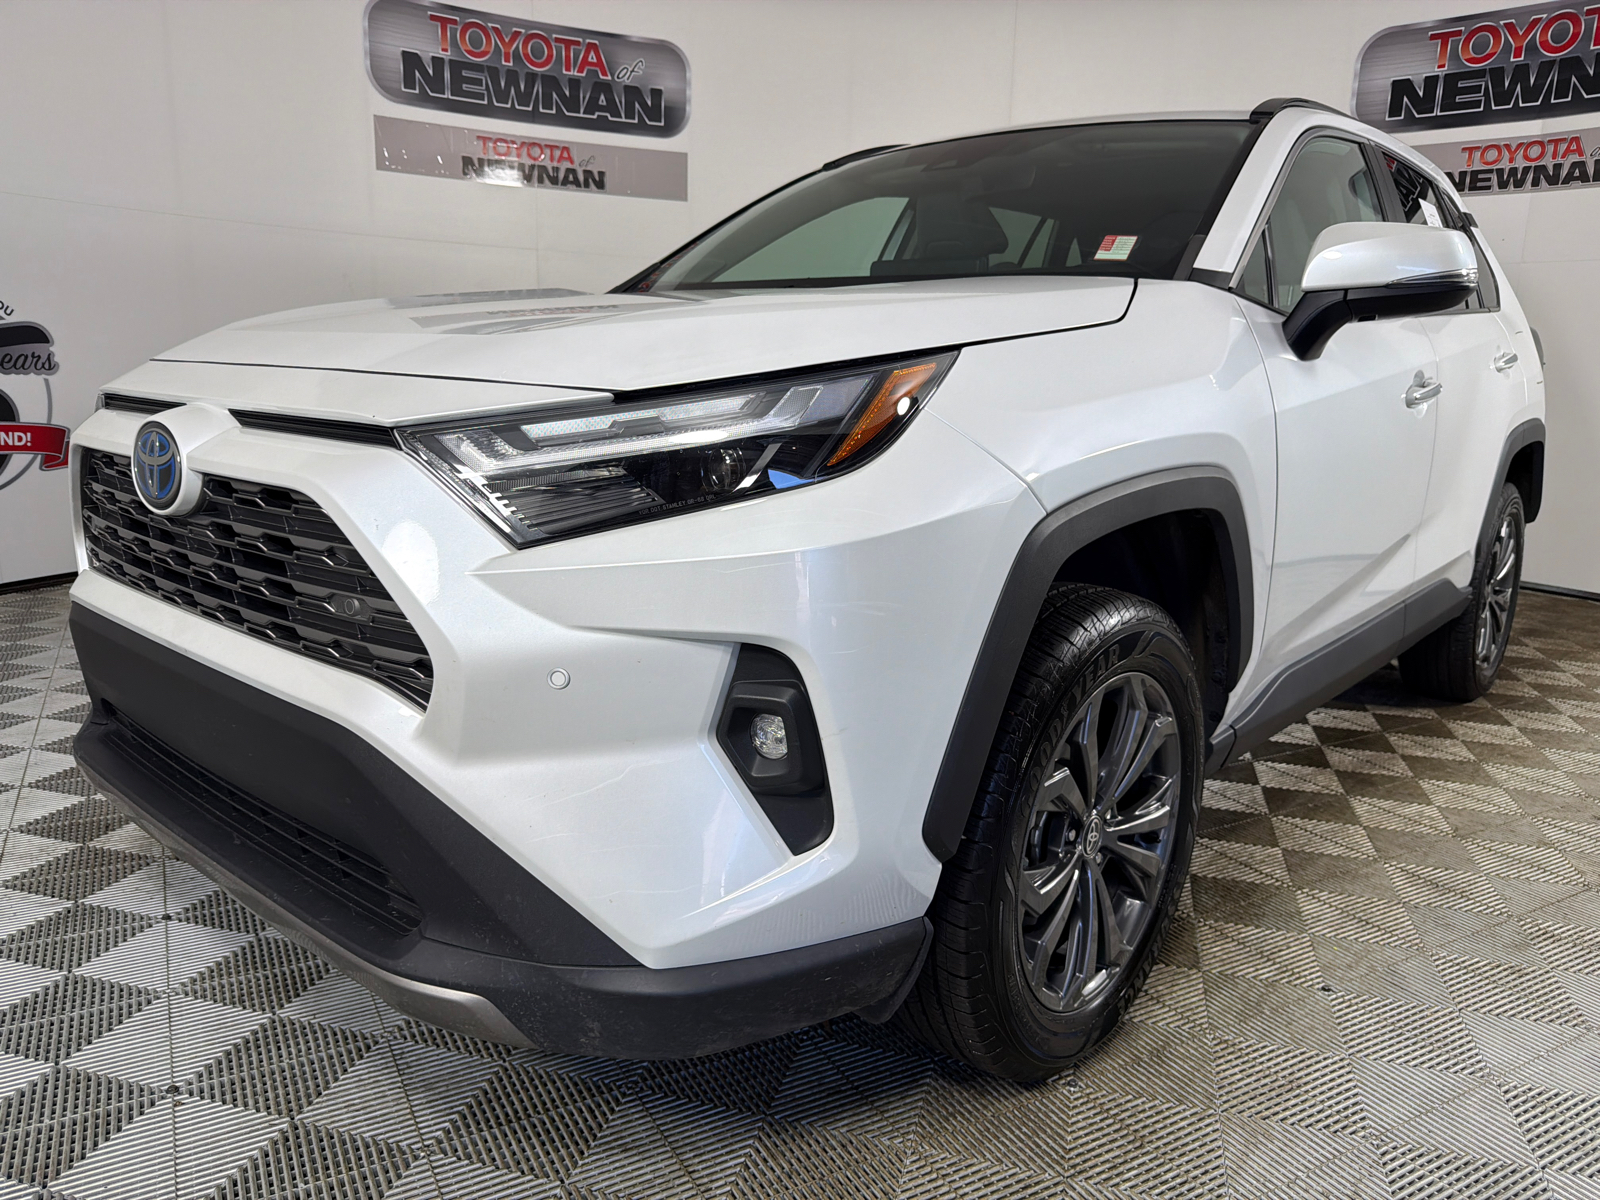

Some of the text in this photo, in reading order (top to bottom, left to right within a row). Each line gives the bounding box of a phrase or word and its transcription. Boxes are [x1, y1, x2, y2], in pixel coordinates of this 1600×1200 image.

[427, 12, 646, 82] TOYOTA of
[400, 48, 665, 126] NEWNAN
[475, 135, 576, 165] TOYOTA
[1461, 135, 1587, 168] TOYOTA
[1444, 158, 1600, 193] NEWNA
[0, 432, 32, 447] ND!
